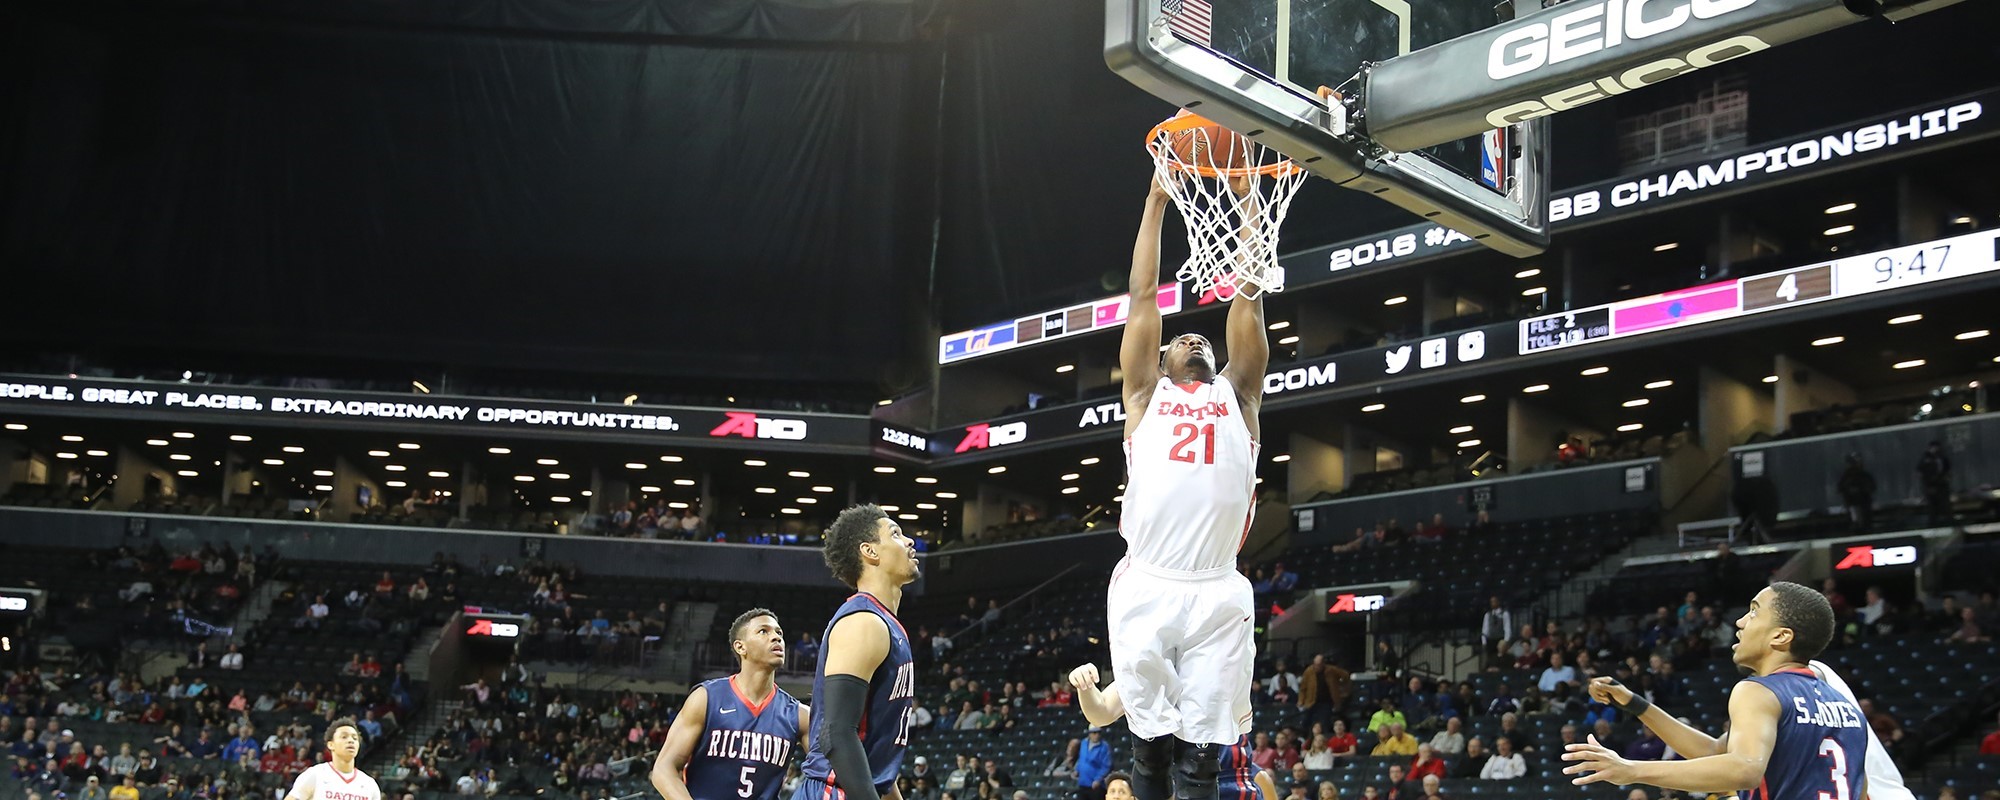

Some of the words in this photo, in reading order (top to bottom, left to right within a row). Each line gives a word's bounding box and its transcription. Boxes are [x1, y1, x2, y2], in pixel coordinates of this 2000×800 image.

[1487, 0, 1756, 80] GEIC
[1330, 233, 1416, 272] 2016
[1611, 101, 1982, 208] CHAMPIONSHIP
[1483, 166, 1496, 183] NBA
[1875, 244, 1951, 284] 9:47
[1776, 274, 1798, 301] 4
[1530, 318, 1560, 335] FLS:
[1564, 313, 1576, 329] 2
[81, 387, 159, 405] GREAT
[165, 392, 263, 411] PLACES.
[270, 397, 470, 421] EXTRAORDINARY
[477, 407, 680, 431] OPPORTUNITIES.
[710, 411, 807, 440] A10
[1158, 401, 1229, 421] DAYTON
[910, 435, 926, 451] PM
[954, 421, 1028, 454] A10
[1169, 422, 1215, 465] 21
[1835, 545, 1917, 570] A10
[466, 619, 519, 637] A10
[1793, 696, 1862, 729] S.JONES
[707, 729, 791, 768] RICHMOND
[737, 766, 757, 799] 5
[1818, 737, 1850, 800] 3
